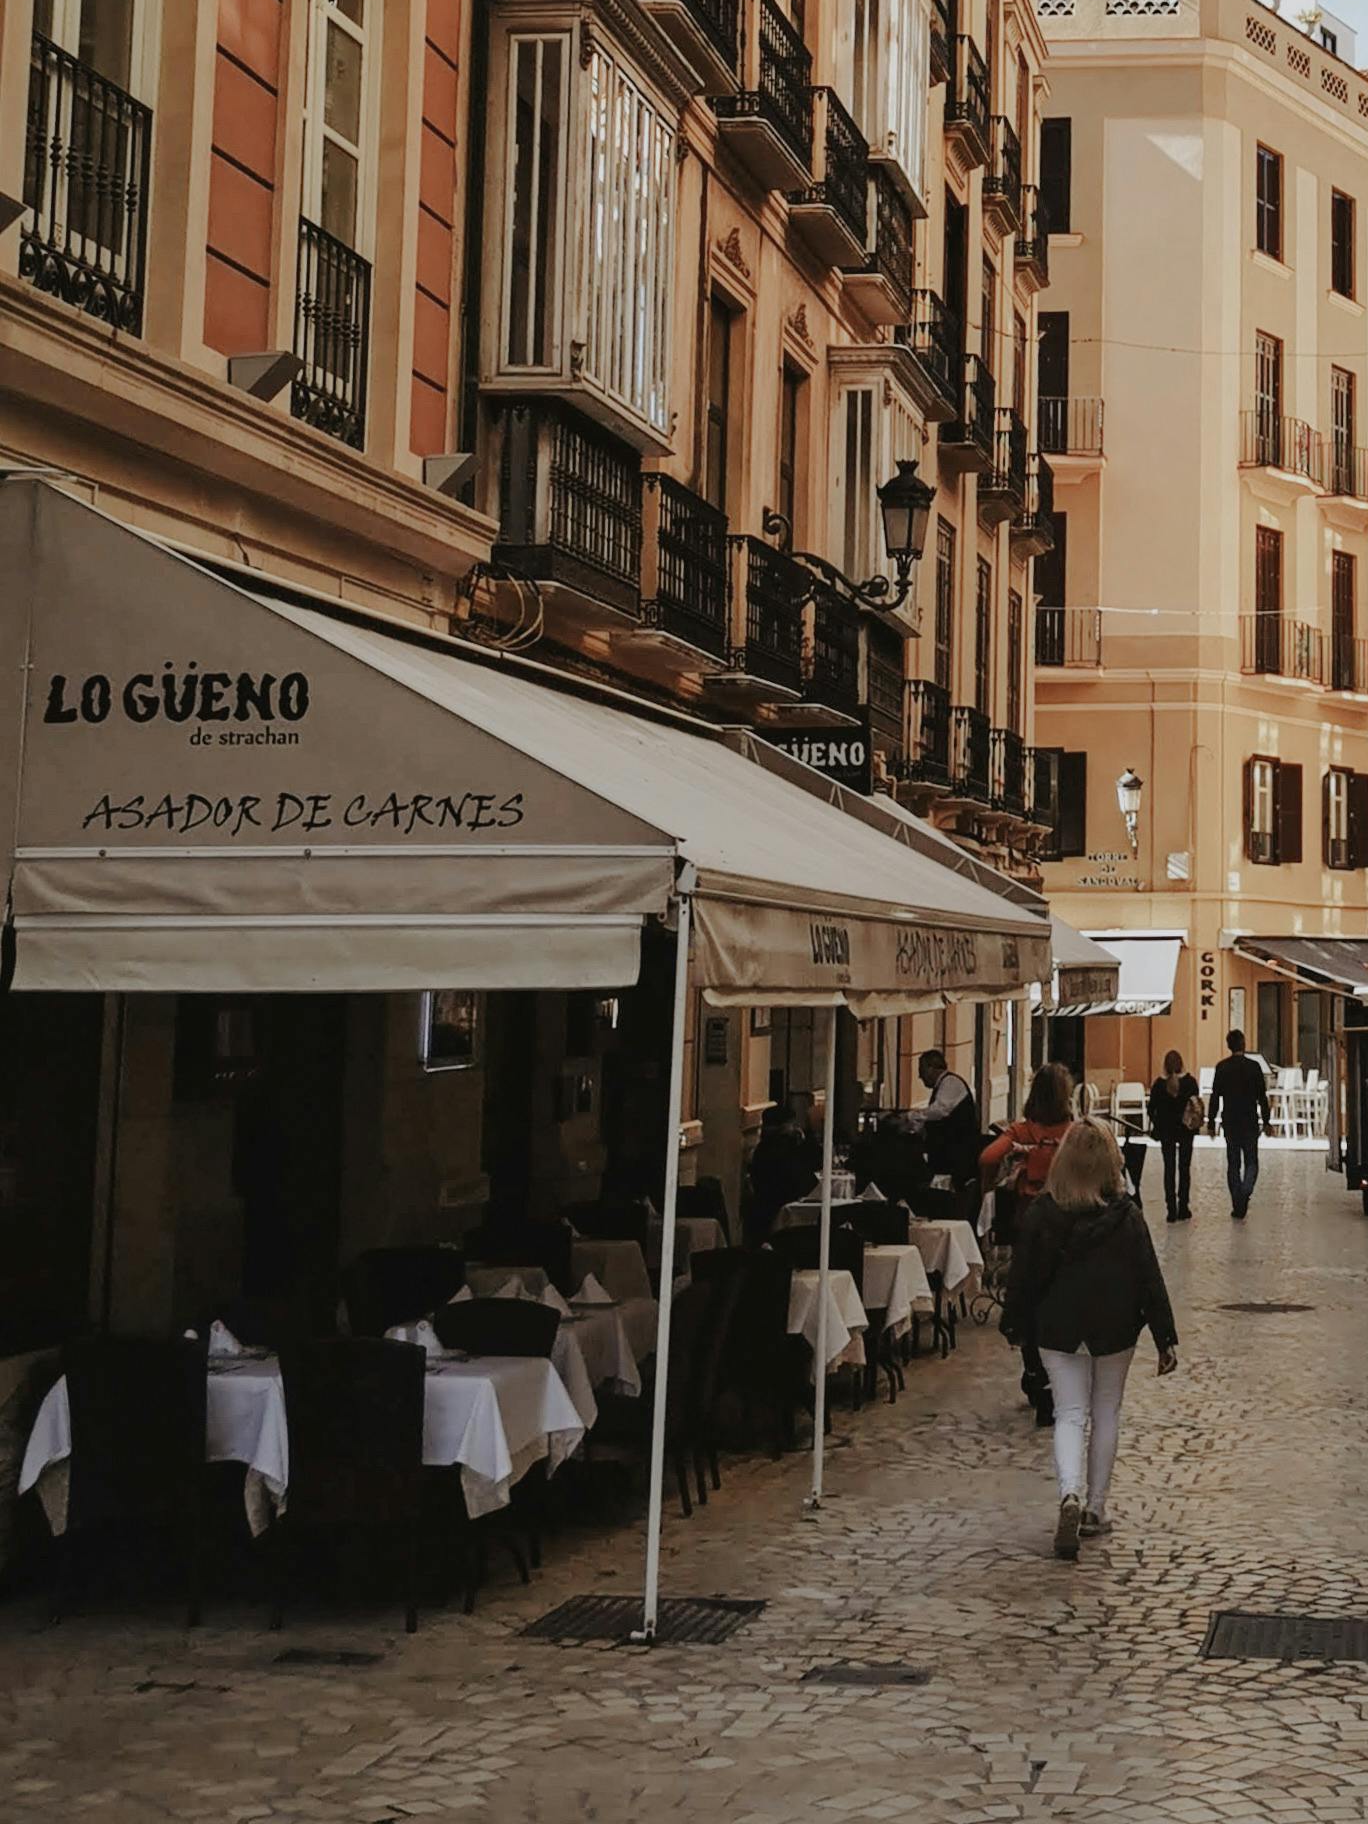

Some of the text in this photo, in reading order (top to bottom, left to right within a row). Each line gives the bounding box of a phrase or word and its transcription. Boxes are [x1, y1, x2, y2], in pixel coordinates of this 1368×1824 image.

[43, 661, 309, 723] LO GÜENO
[190, 726, 299, 745] de strachan
[777, 737, 865, 767] ÜENO
[82, 792, 525, 836] ASADOR DE CARNES
[1201, 951, 1216, 1020] GORKI
